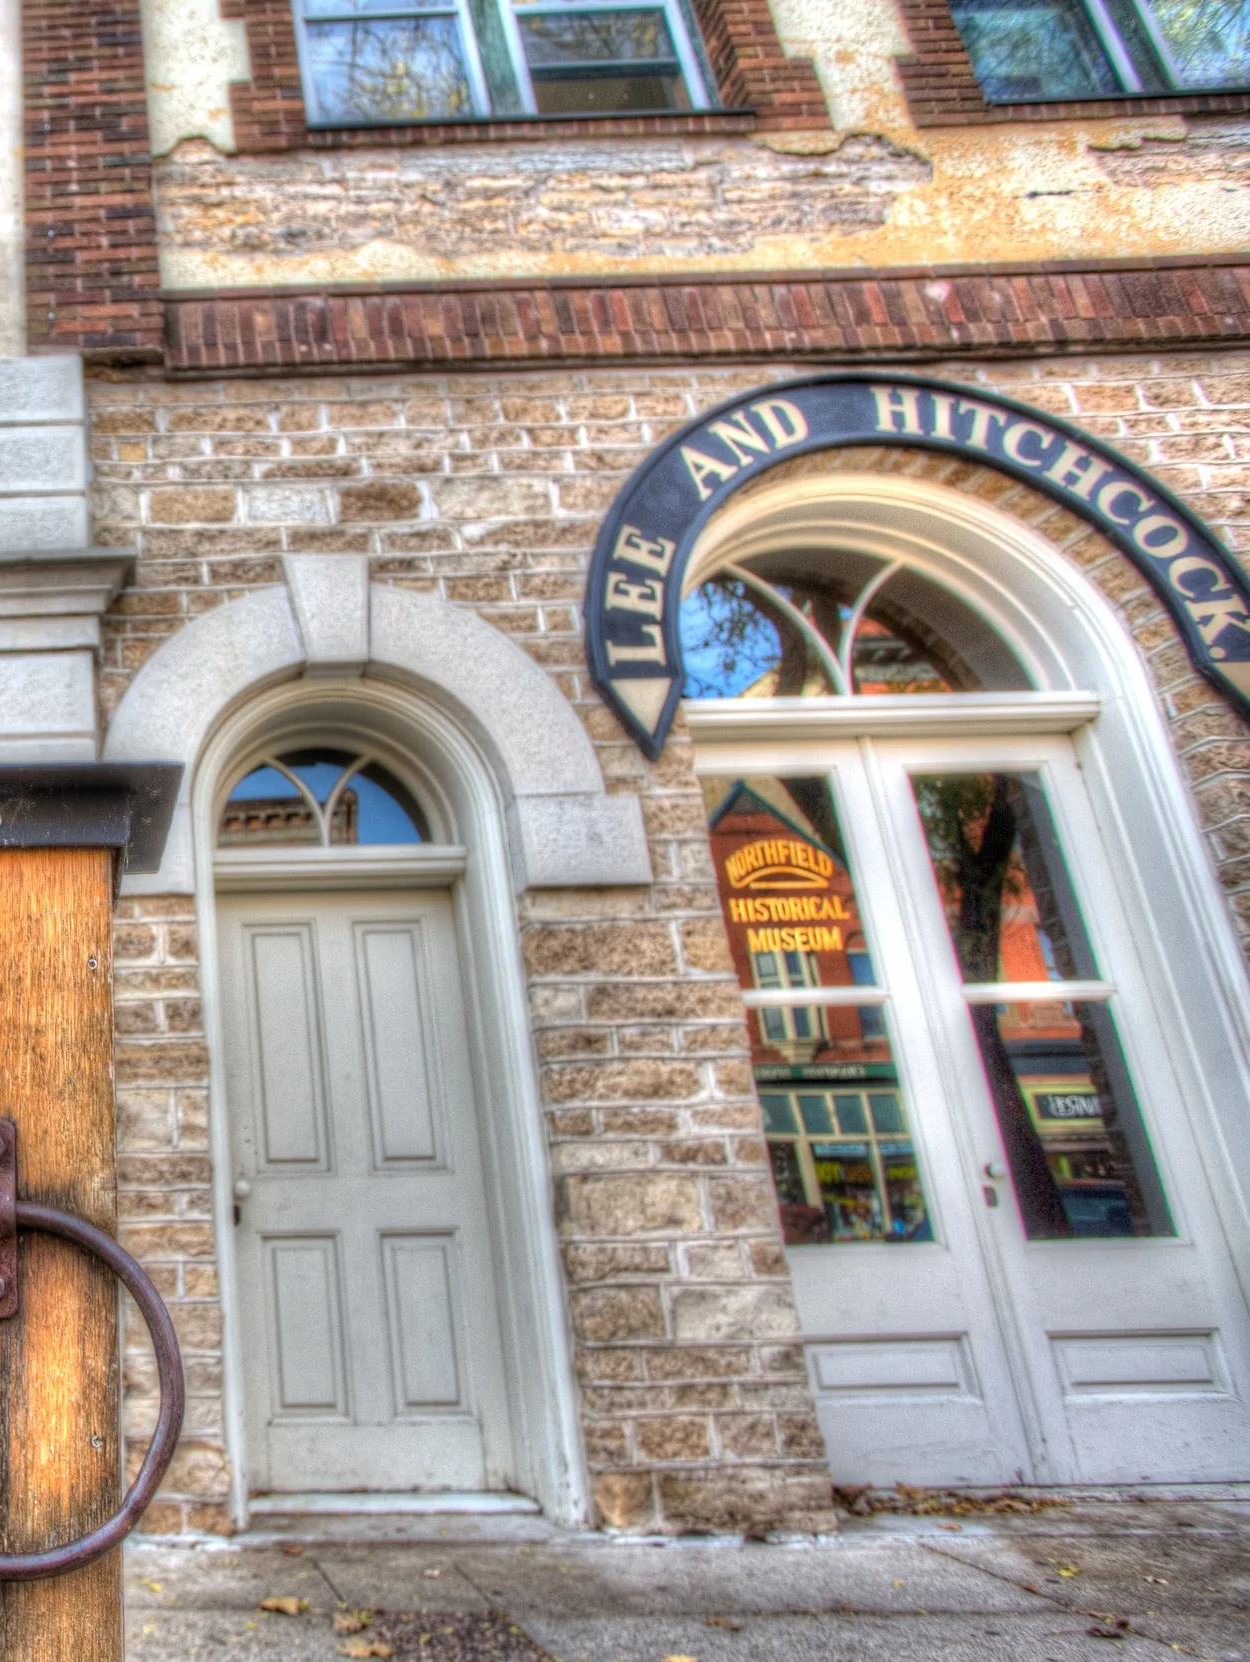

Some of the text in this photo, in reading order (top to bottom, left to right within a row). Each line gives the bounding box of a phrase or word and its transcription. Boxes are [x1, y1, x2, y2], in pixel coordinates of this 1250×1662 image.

[606, 523, 675, 667] LEE
[677, 398, 809, 500] AND
[725, 839, 833, 881] NORTHFIELD
[729, 895, 851, 923] HISTORICAL
[747, 926, 843, 953] MUSEUM
